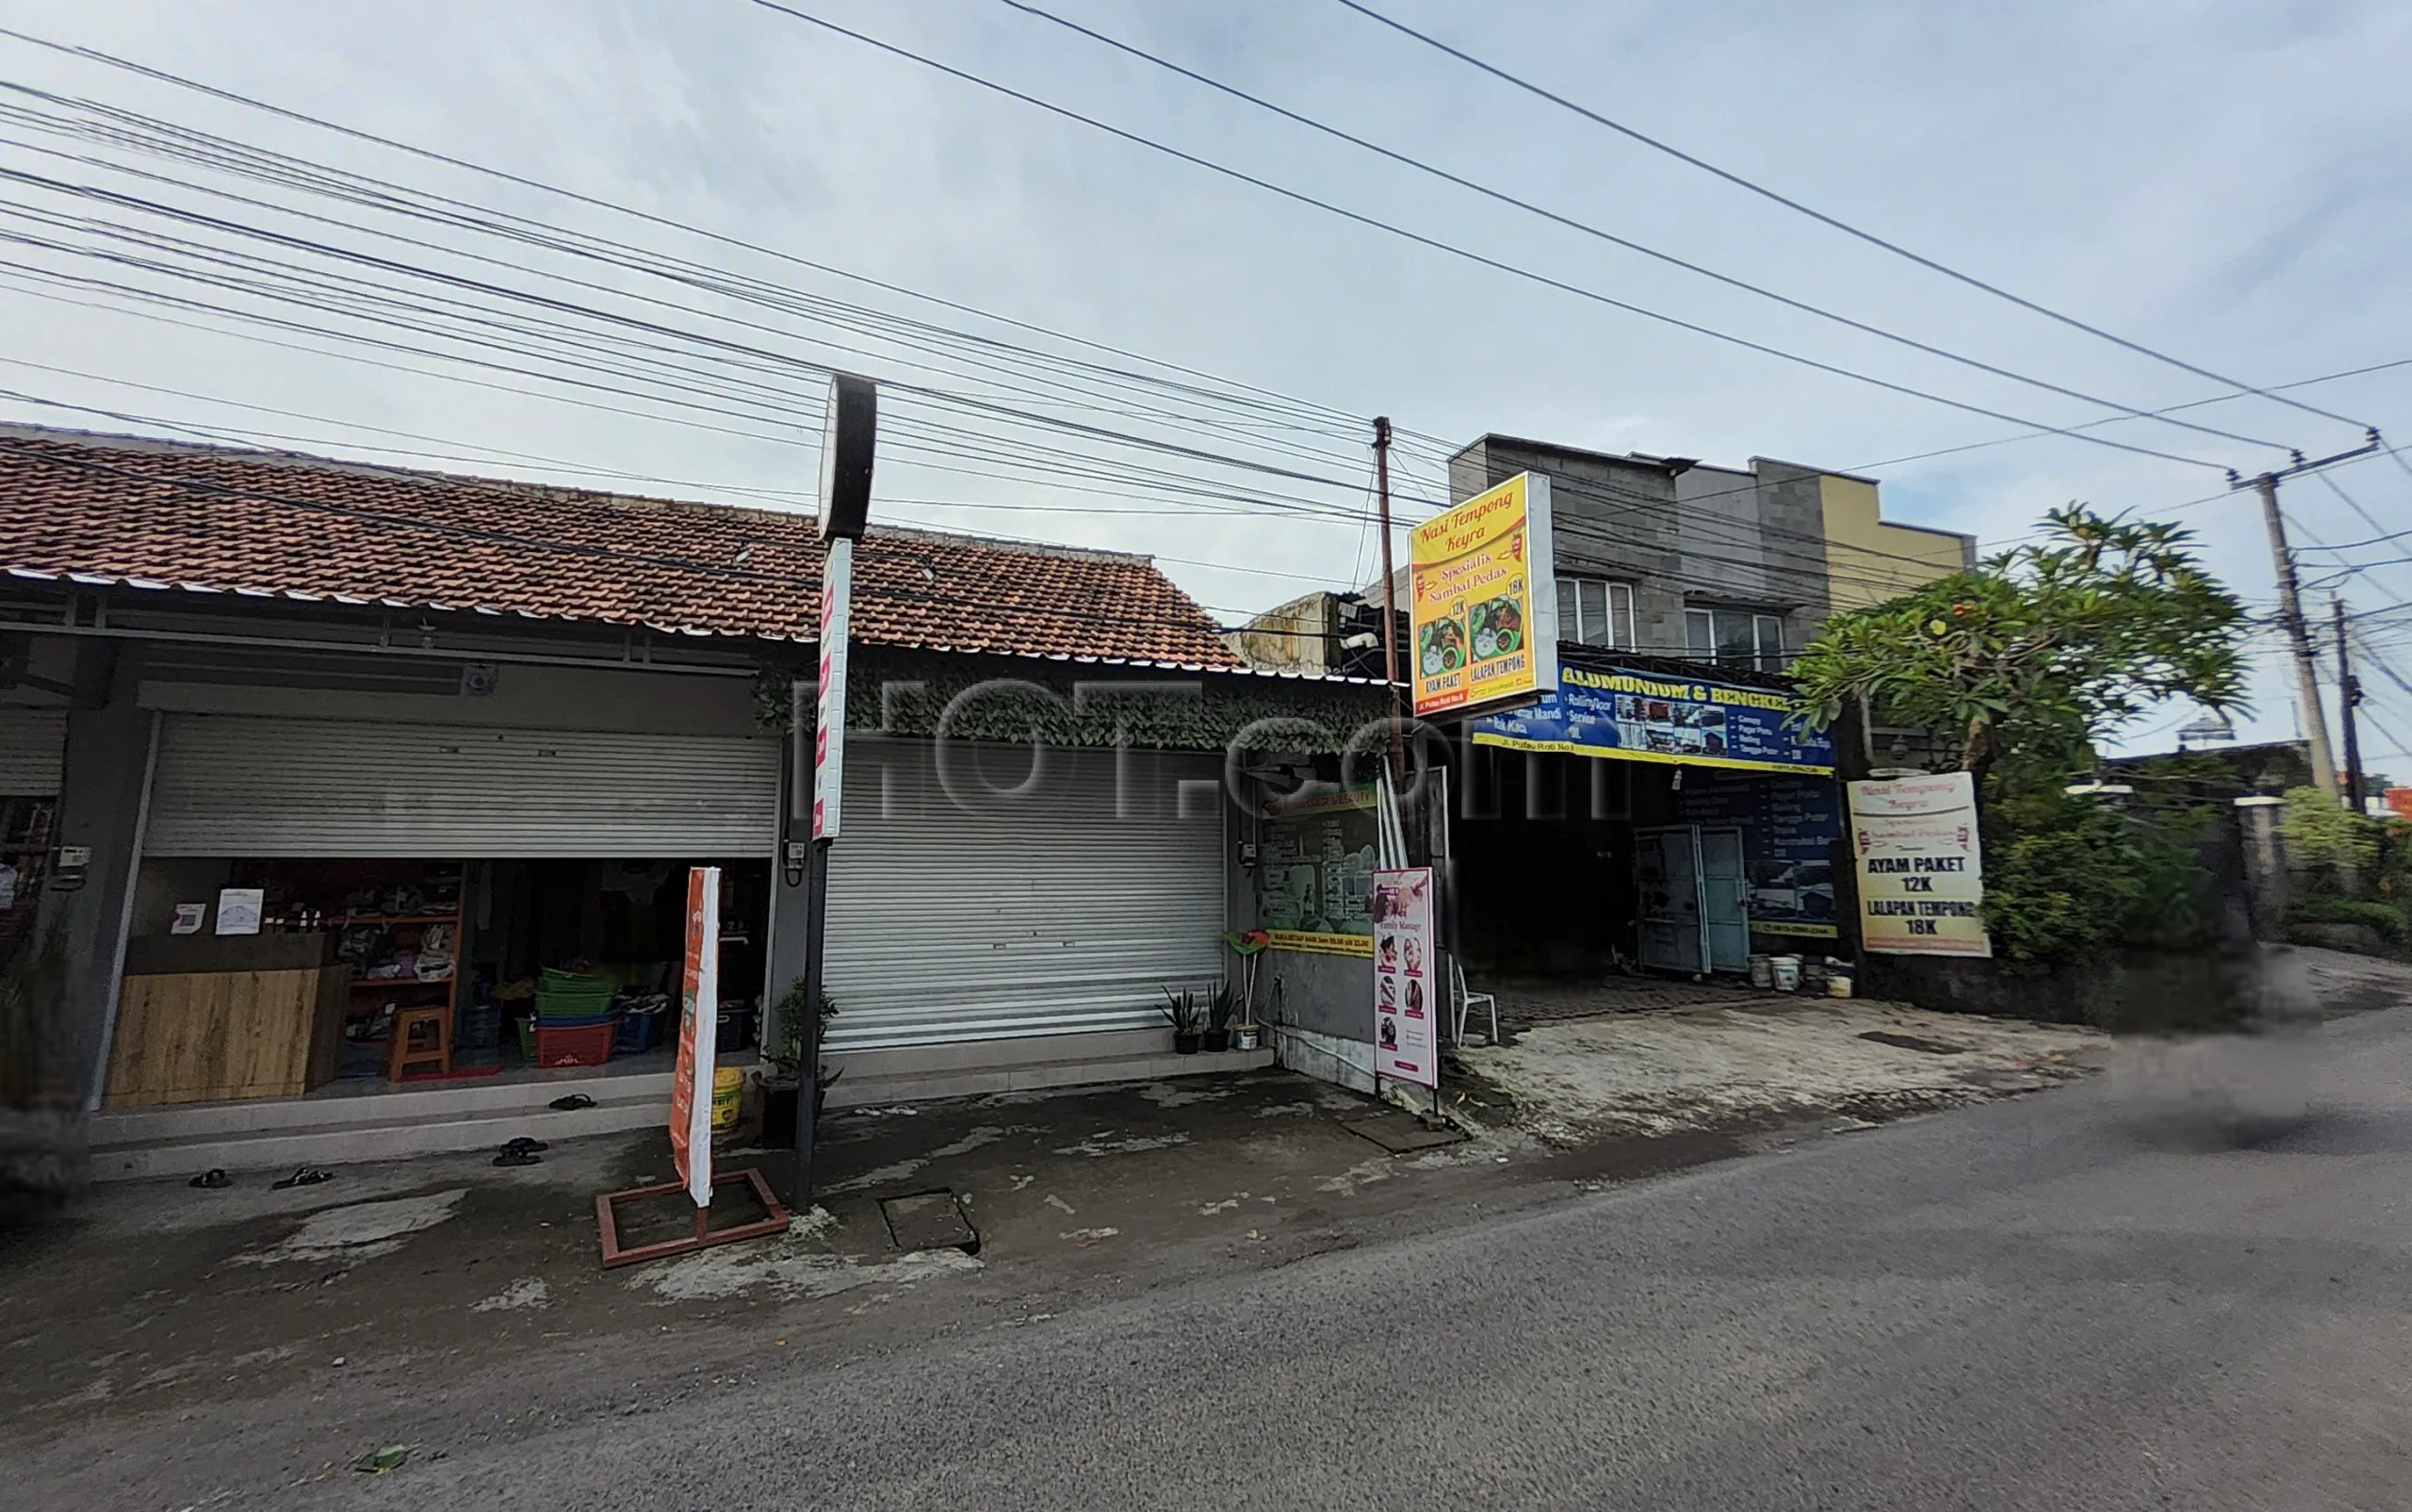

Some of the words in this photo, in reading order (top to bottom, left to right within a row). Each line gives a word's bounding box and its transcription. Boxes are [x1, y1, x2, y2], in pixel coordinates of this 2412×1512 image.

[1420, 519, 1448, 545] Nasi
[1451, 492, 1513, 529] Tempong
[1445, 526, 1486, 553] Keyra
[1441, 553, 1492, 581] Spesialis
[1428, 579, 1471, 604] Sambal
[1473, 567, 1508, 588] Pedas
[1562, 667, 1687, 699] ALUMUNIUM
[1693, 685, 1706, 703] &
[1711, 690, 1791, 712] BENGKEL
[1512, 740, 1536, 750] Pulau
[1537, 742, 1555, 751] Roti
[1867, 857, 1911, 873] AYAM
[1914, 856, 1965, 872] PAKET
[1901, 876, 1934, 893] 12K
[1866, 900, 1915, 916] LALAPAN
[1904, 919, 1939, 935] 18K
